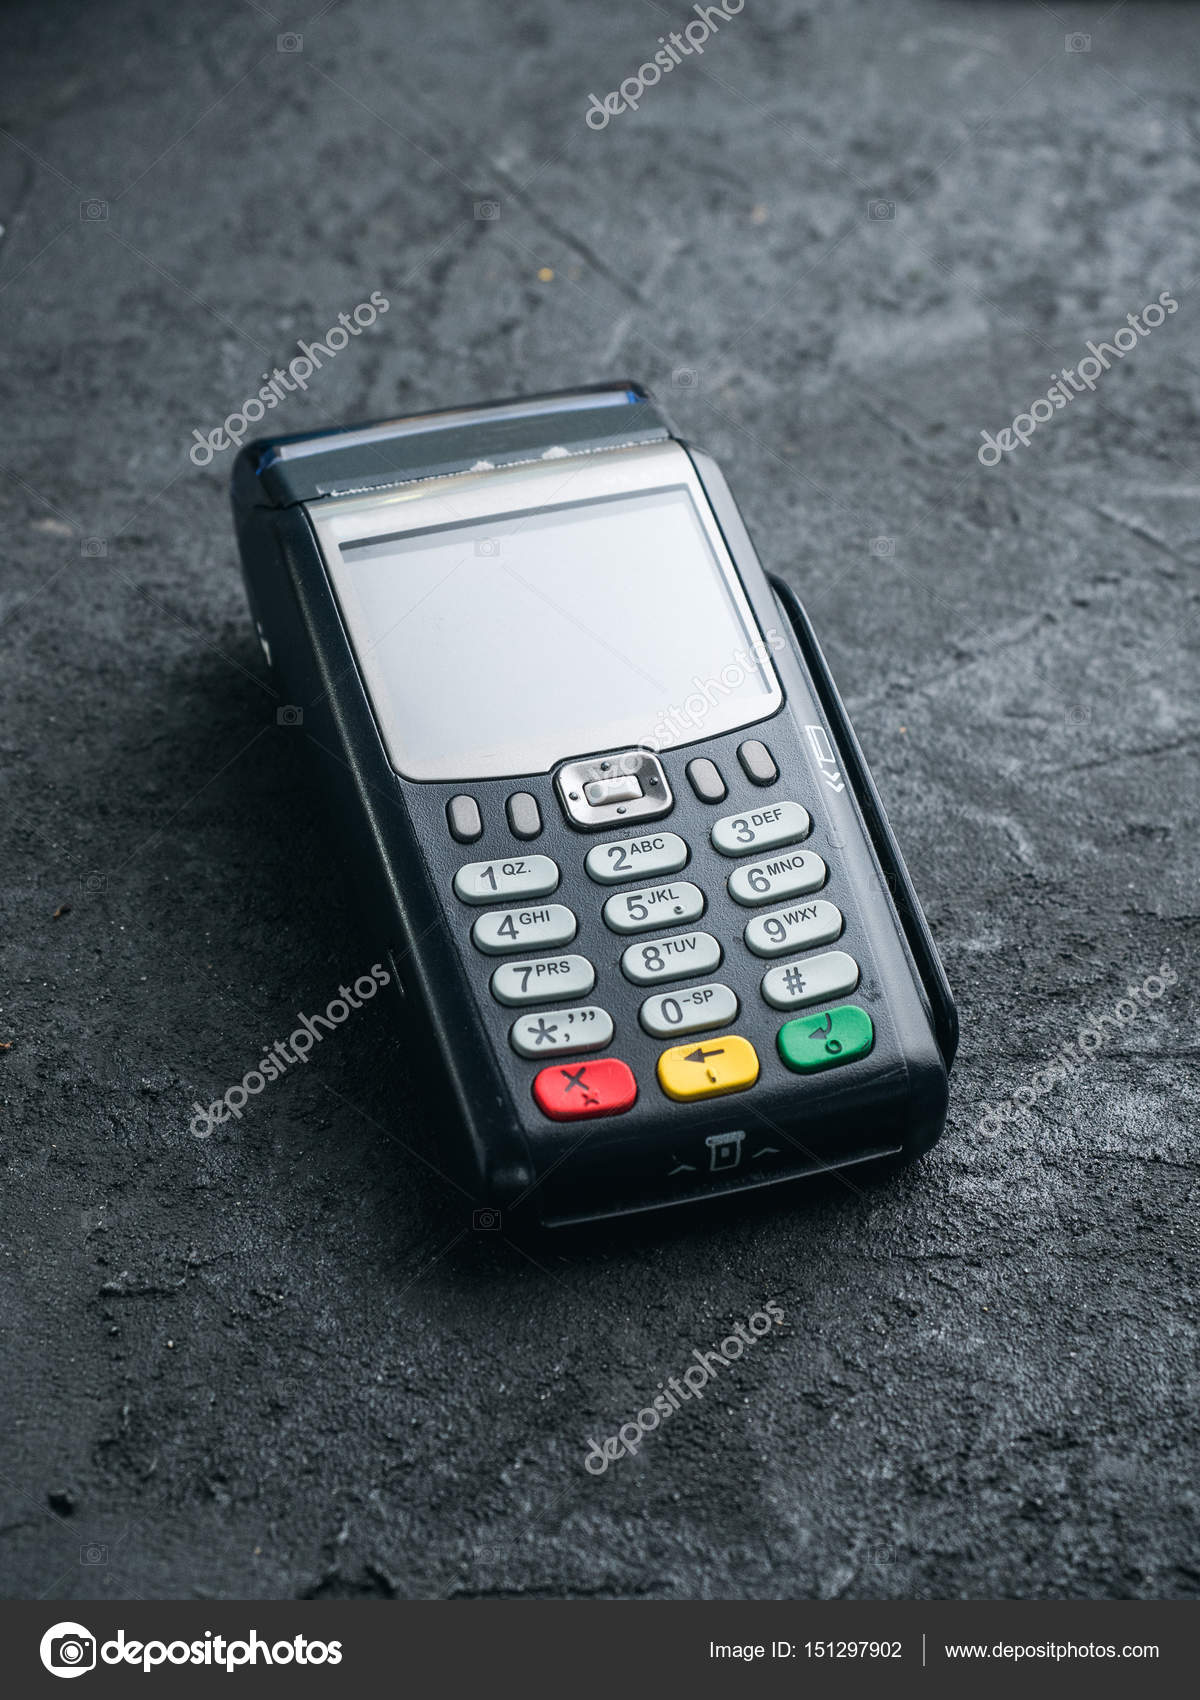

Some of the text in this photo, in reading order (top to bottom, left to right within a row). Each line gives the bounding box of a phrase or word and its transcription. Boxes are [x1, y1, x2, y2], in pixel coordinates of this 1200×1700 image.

[731, 808, 783, 843] 3 DEF
[607, 838, 665, 872] 2 ABC
[479, 865, 498, 891] 1
[747, 856, 805, 893] 6 MNO
[626, 888, 680, 921] 5 JKL
[496, 909, 551, 940] 4 GHI
[763, 905, 817, 944] 9 WXY
[641, 936, 696, 972] 8 TUV
[512, 960, 571, 993] 7 PRS
[660, 997, 684, 1025] 0
